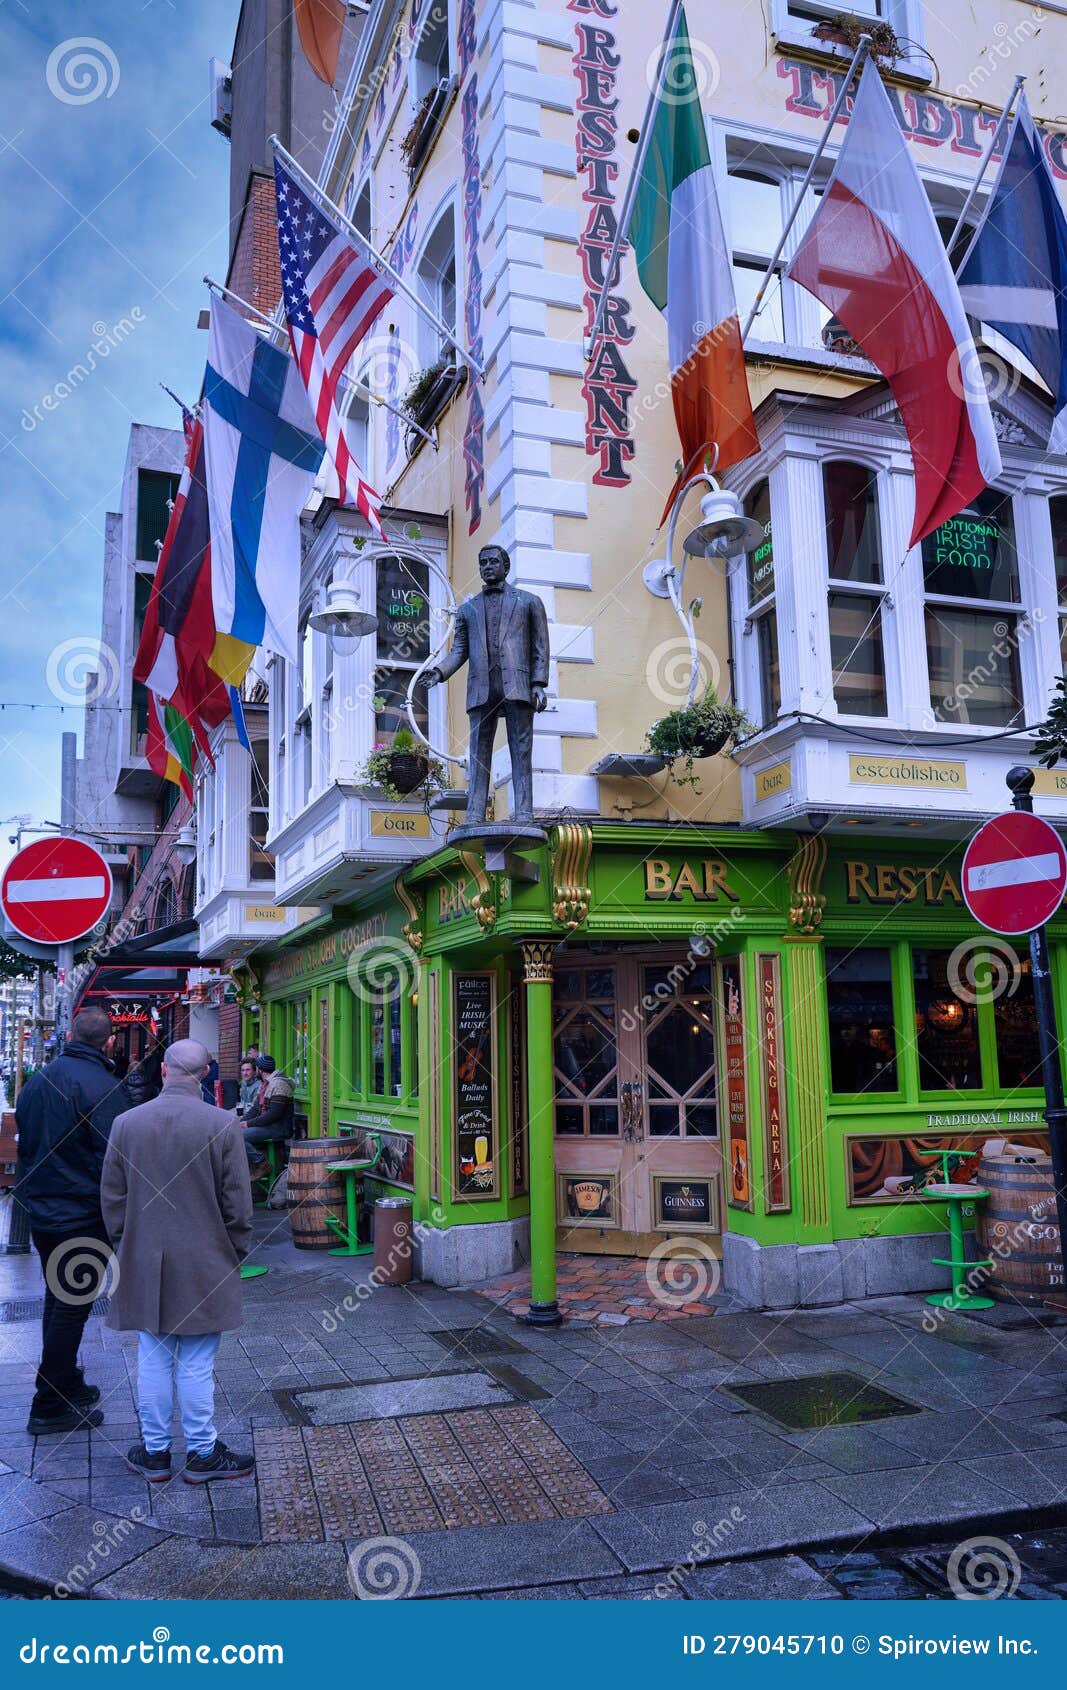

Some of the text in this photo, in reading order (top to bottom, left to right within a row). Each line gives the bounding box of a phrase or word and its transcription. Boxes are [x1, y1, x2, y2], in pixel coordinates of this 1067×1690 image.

[572, 21, 637, 488] RESTAURANT
[936, 530, 987, 551] IRISH
[936, 548, 991, 569] FOOD
[389, 604, 420, 617] IRISH
[855, 760, 960, 784] established
[643, 859, 740, 902] BAR
[845, 860, 963, 906] RESTA
[438, 878, 470, 923] BAR
[340, 911, 388, 956] GOGARTY
[461, 1011, 487, 1019] IRISH
[466, 1001, 482, 1010] Live
[459, 1021, 488, 1029] MUSIC
[764, 980, 782, 1171] SMOKING AREA
[461, 1083, 488, 1092] Ballads
[465, 1094, 485, 1103] Daily
[1007, 1110, 1039, 1123] IRISH
[664, 1195, 705, 1208] GUINNESS
